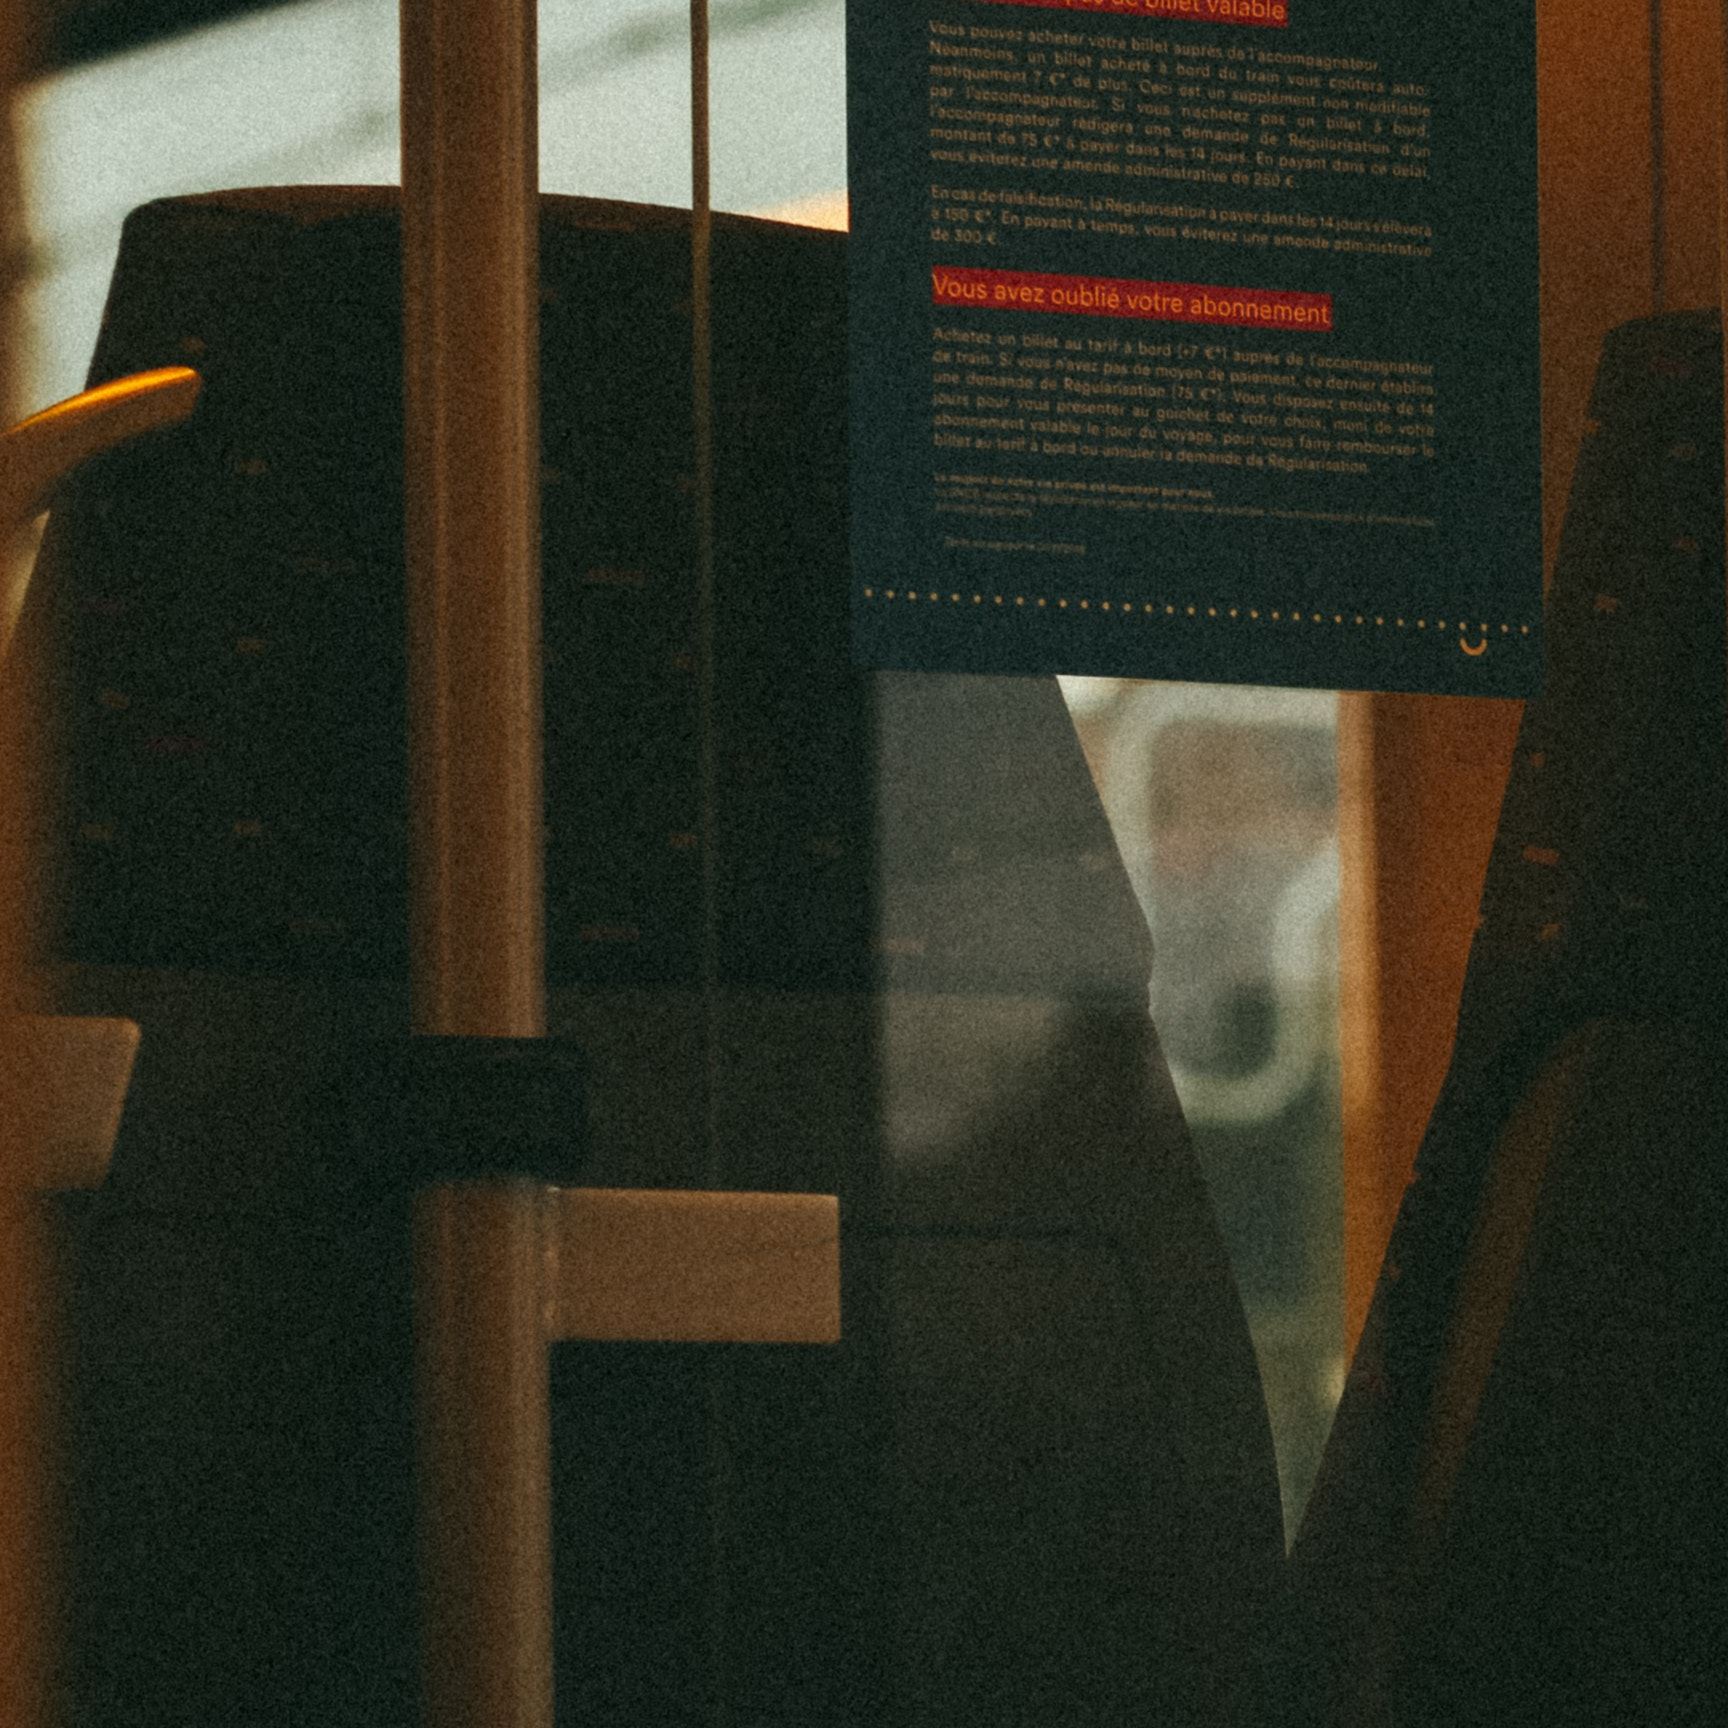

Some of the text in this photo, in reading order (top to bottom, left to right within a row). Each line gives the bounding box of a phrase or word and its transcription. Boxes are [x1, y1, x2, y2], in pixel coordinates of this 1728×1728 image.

[932, 274, 1329, 323] Vous avez oublié votre abonnement
